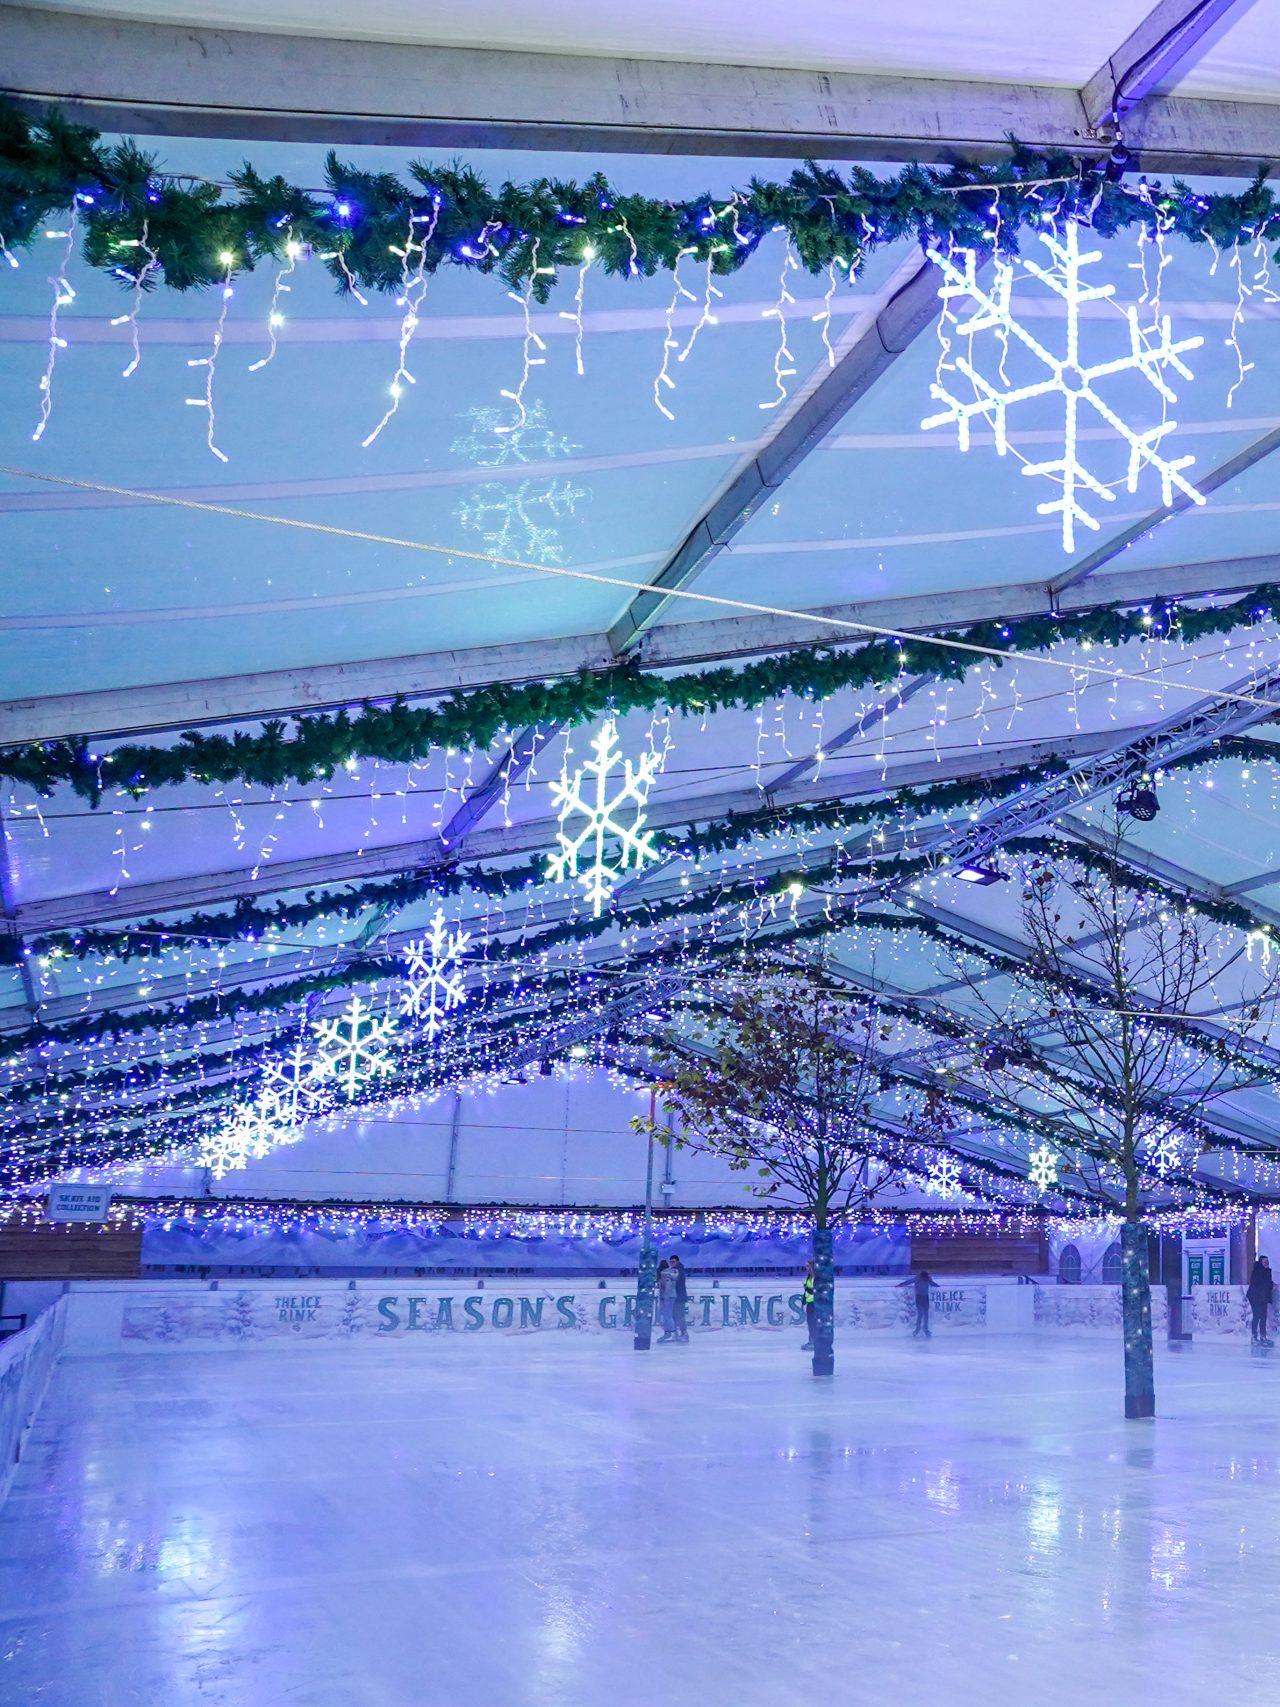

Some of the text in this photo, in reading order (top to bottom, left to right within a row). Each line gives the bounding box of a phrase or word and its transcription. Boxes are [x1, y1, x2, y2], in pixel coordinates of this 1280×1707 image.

[56, 1203, 101, 1212] COLLECTION
[275, 1295, 322, 1309] THE ICE
[931, 1290, 965, 1302] THE ICE
[1207, 1291, 1231, 1304] THE ICE
[934, 1301, 962, 1313] RINK
[1209, 1303, 1228, 1317] RINK
[279, 1309, 317, 1321] RINK
